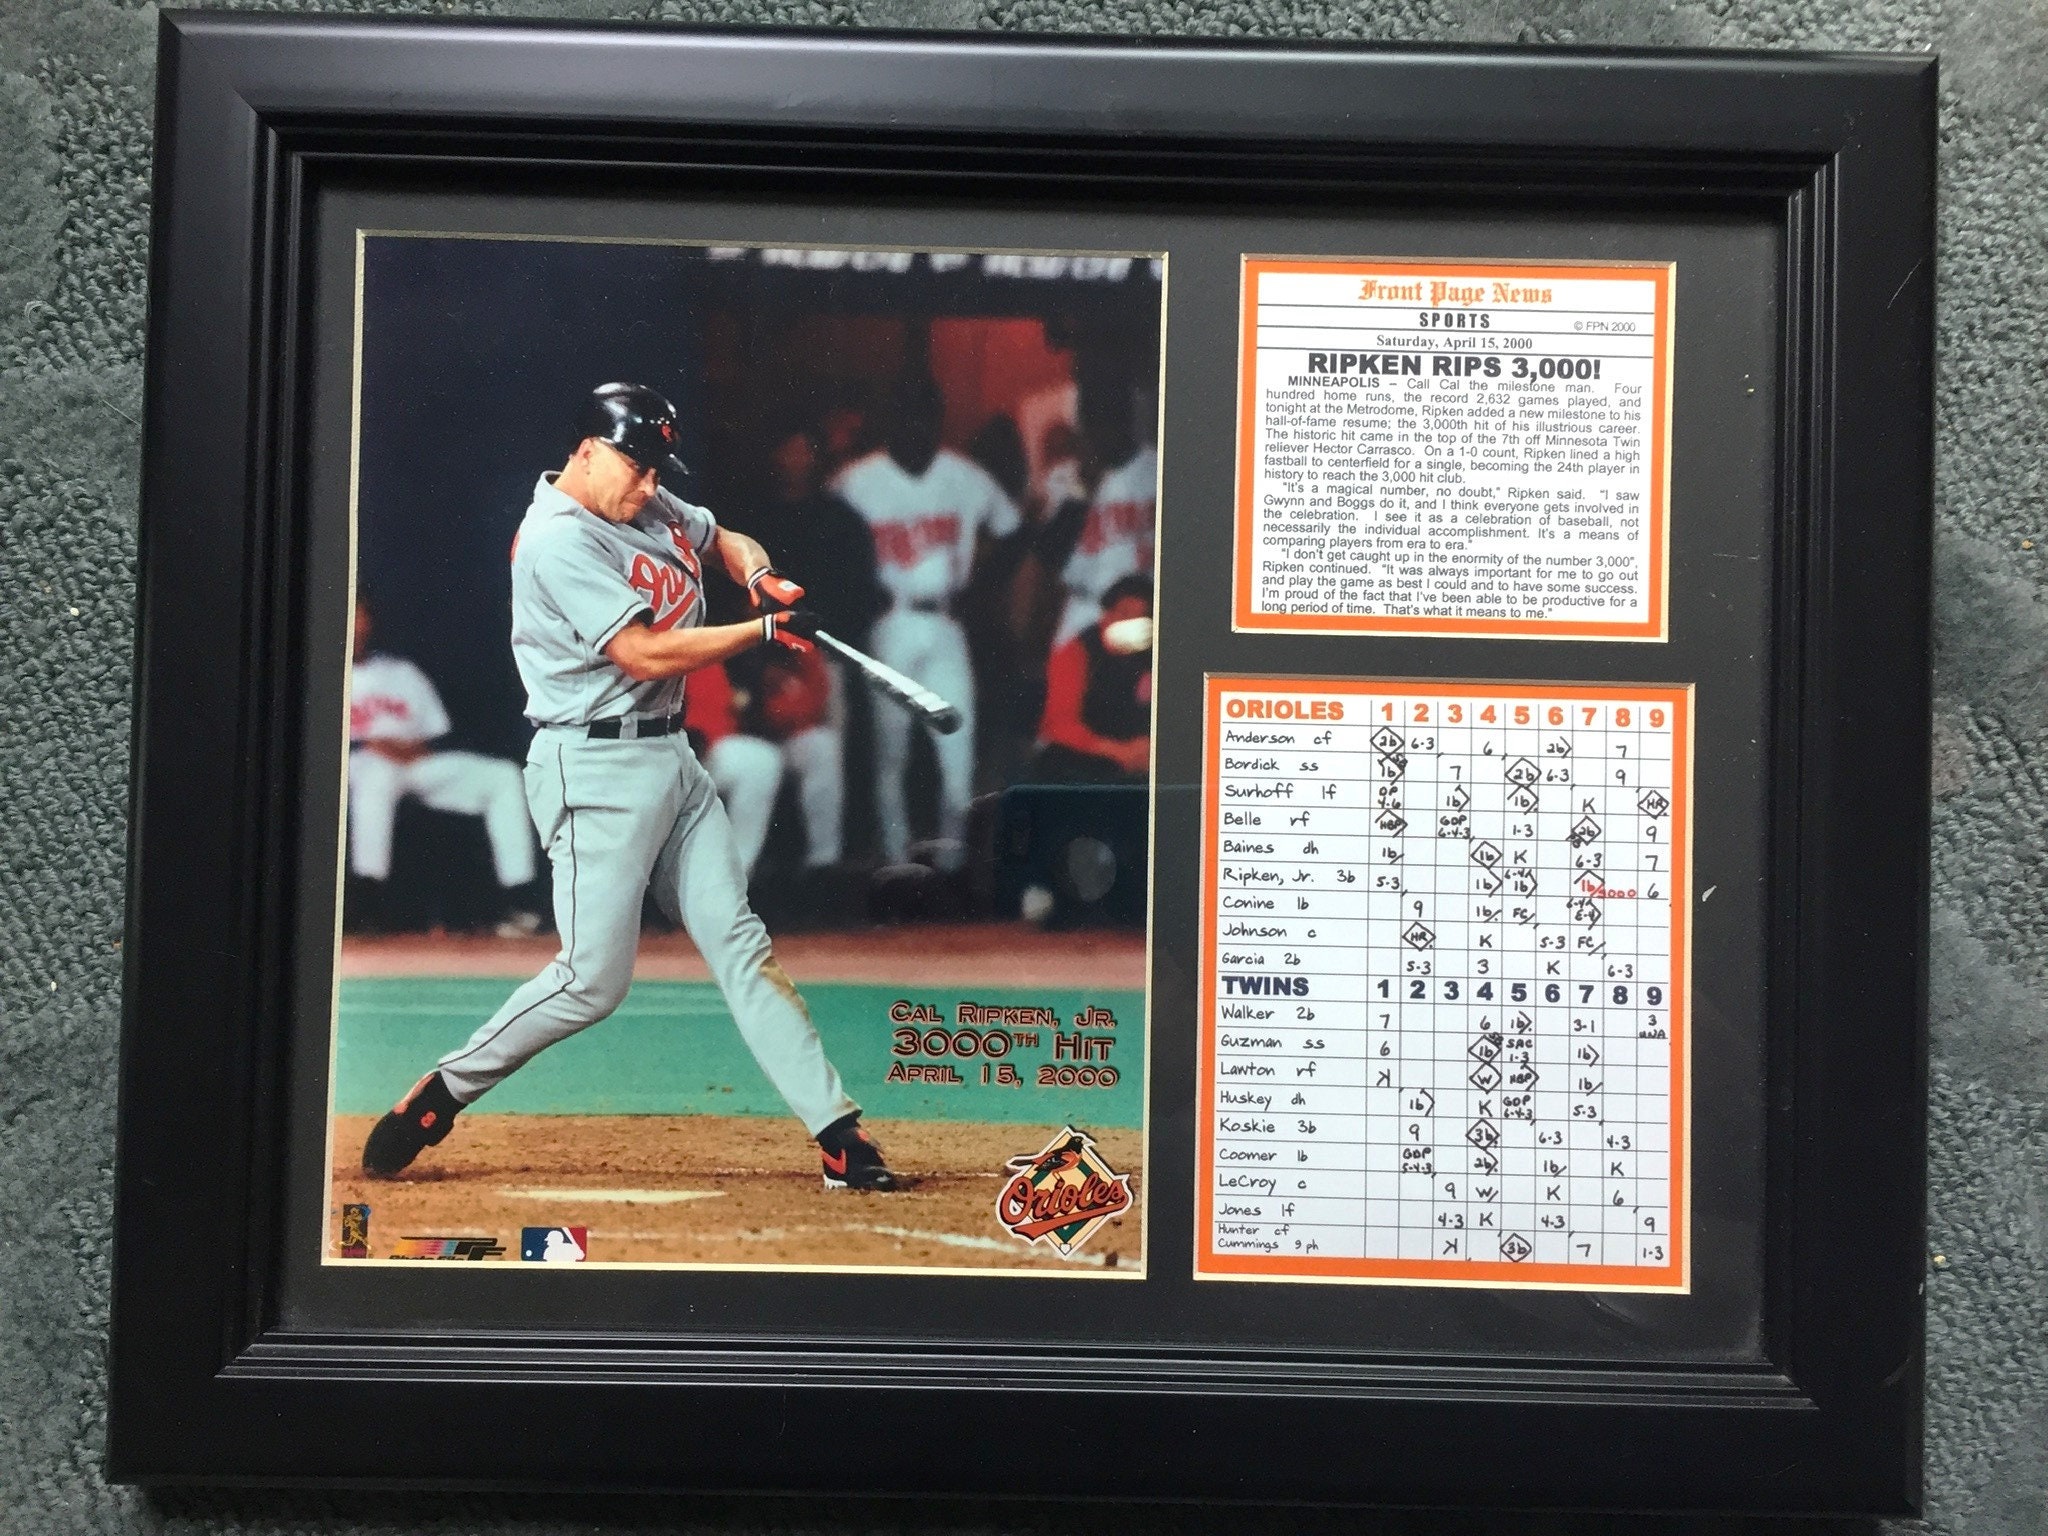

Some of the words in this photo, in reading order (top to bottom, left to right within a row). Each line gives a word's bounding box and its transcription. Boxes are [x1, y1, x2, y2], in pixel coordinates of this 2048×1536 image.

[1358, 280, 1422, 300] Front
[1430, 282, 1485, 308] Page
[1492, 282, 1552, 304] News
[1420, 312, 1490, 328] SPORTS
[1586, 322, 1608, 332] FPN
[1611, 322, 1636, 332] 2000
[1376, 335, 1439, 349] Saturday,
[1443, 337, 1476, 350] April
[1480, 338, 1499, 350] 15,
[1503, 338, 1532, 349] 2000
[1308, 353, 1422, 375] RIPKEN
[1433, 356, 1501, 377] RIPS
[1511, 357, 1601, 383] 3,000!
[1288, 375, 1380, 389] MINNEAPOLIS
[1406, 378, 1430, 390] Call
[1439, 379, 1460, 391] Cal
[1469, 380, 1488, 391] the
[1497, 381, 1556, 393] milestone
[1565, 384, 1594, 393] man.
[1614, 383, 1642, 395] Four
[1266, 388, 1315, 401] hundred
[1324, 390, 1357, 402] home
[1366, 392, 1395, 404] runs,
[1404, 392, 1422, 403] the
[1430, 393, 1468, 404] record
[1476, 394, 1511, 406] 2,632
[1518, 396, 1560, 408] games
[1568, 396, 1611, 409] played,
[1618, 398, 1641, 408] and
[1266, 402, 1306, 416] tonight
[1309, 403, 1321, 414] at
[1324, 403, 1343, 415] the
[1346, 403, 1418, 417] Metrodome,
[1422, 405, 1464, 419] Ripken
[1466, 407, 1505, 418] added
[1508, 409, 1516, 418] a
[1519, 409, 1544, 419] new
[1547, 409, 1606, 421] milestone
[1609, 410, 1620, 421] to
[1624, 410, 1641, 421] his
[1264, 495, 1305, 509] Gwynn
[1309, 496, 1332, 507] and
[1336, 496, 1376, 511] Boggs
[1379, 498, 1394, 509] do
[1399, 498, 1410, 511] it,
[1414, 499, 1437, 510] and
[1442, 499, 1446, 510] I
[1450, 499, 1479, 511] think
[1484, 502, 1540, 515] everyone
[1543, 502, 1570, 515] gets
[1574, 503, 1624, 514] involved
[1628, 505, 1639, 514] in
[1262, 561, 1304, 575] Ripken
[1308, 563, 1371, 575] continued.
[1398, 566, 1424, 576] was
[1428, 566, 1470, 580] always
[1474, 567, 1532, 580] important
[1536, 568, 1553, 579] for
[1557, 570, 1577, 580] me
[1582, 569, 1594, 580] to
[1598, 571, 1614, 583] go
[1618, 571, 1638, 581] out
[1227, 699, 1344, 720] ORIOLES
[1382, 703, 1393, 721] 1
[1414, 704, 1429, 722] 2
[1448, 704, 1462, 722] 3
[1480, 705, 1496, 723] 4
[1514, 706, 1530, 724] 5
[1548, 707, 1564, 725] 6
[1582, 708, 1597, 725] 7
[1616, 708, 1630, 727] 8
[1650, 709, 1664, 727] 9
[1226, 730, 1295, 744] Anderson
[1314, 732, 1332, 744] cf
[1484, 741, 1492, 755] 6
[1225, 757, 1280, 770] Bordick
[1299, 762, 1319, 771] ss
[1616, 769, 1625, 786] 9
[1225, 783, 1294, 798] Surhoff
[1583, 797, 1596, 813] K
[1224, 812, 1261, 825] Belle
[1290, 811, 1310, 827] rf
[1646, 826, 1657, 842] 9
[1223, 840, 1274, 854] Baines
[1303, 841, 1319, 855] dh
[1514, 850, 1527, 864] K
[1223, 868, 1284, 886] Ripken,
[1292, 870, 1314, 882] Jr.
[1337, 870, 1355, 883] 3b
[1647, 883, 1659, 898] 6
[1223, 896, 1275, 910] Conine
[1414, 901, 1423, 918] 9
[1223, 923, 1287, 937] Johnson
[1480, 934, 1492, 948] K
[1222, 953, 1265, 965] Garcia
[1284, 953, 1301, 965] 2b
[1478, 959, 1489, 974] 3
[1547, 960, 1560, 975] K
[1221, 976, 1309, 996] TWINS
[1377, 979, 1389, 998] 1
[1410, 980, 1425, 999] 2
[1444, 981, 1459, 1000] 3
[1477, 982, 1493, 1001] 4
[1511, 983, 1527, 1001] 5
[1545, 984, 1560, 1003] 6
[1579, 985, 1594, 1003] 7
[1612, 986, 1628, 1005] 8
[1647, 987, 1662, 1005] 9
[1222, 1005, 1275, 1019] Walker
[1296, 1007, 1315, 1020] 2b
[1480, 1015, 1491, 1030] 6
[1221, 1034, 1282, 1048] Guzman
[1303, 1039, 1325, 1049] ss
[1380, 1041, 1390, 1055] 6
[1037, 1066, 1119, 1088] 2000
[1221, 1062, 1275, 1075] Lawton
[1296, 1062, 1316, 1077] rf
[1220, 1091, 1272, 1111] Huskey
[1291, 1092, 1306, 1105] dh
[1479, 1099, 1492, 1117] K
[1220, 1118, 1275, 1133] Koskie
[1298, 1120, 1316, 1133] 3b
[1409, 1124, 1419, 1141] 9
[1220, 1149, 1277, 1161] Coomer
[1611, 1162, 1624, 1176] K
[1219, 1174, 1276, 1196] LeCroy
[1445, 1182, 1456, 1199] 9
[1547, 1185, 1560, 1201] K
[1613, 1190, 1624, 1206] 6
[1000, 1172, 1130, 1233] Orioles
[1219, 1203, 1262, 1216] Jones
[1480, 1212, 1493, 1226] K
[1644, 1217, 1655, 1232] 9
[1218, 1225, 1259, 1235] Hunter
[1275, 1225, 1289, 1235] cf
[1218, 1239, 1279, 1252] Cummings
[1306, 1240, 1319, 1254] ph
